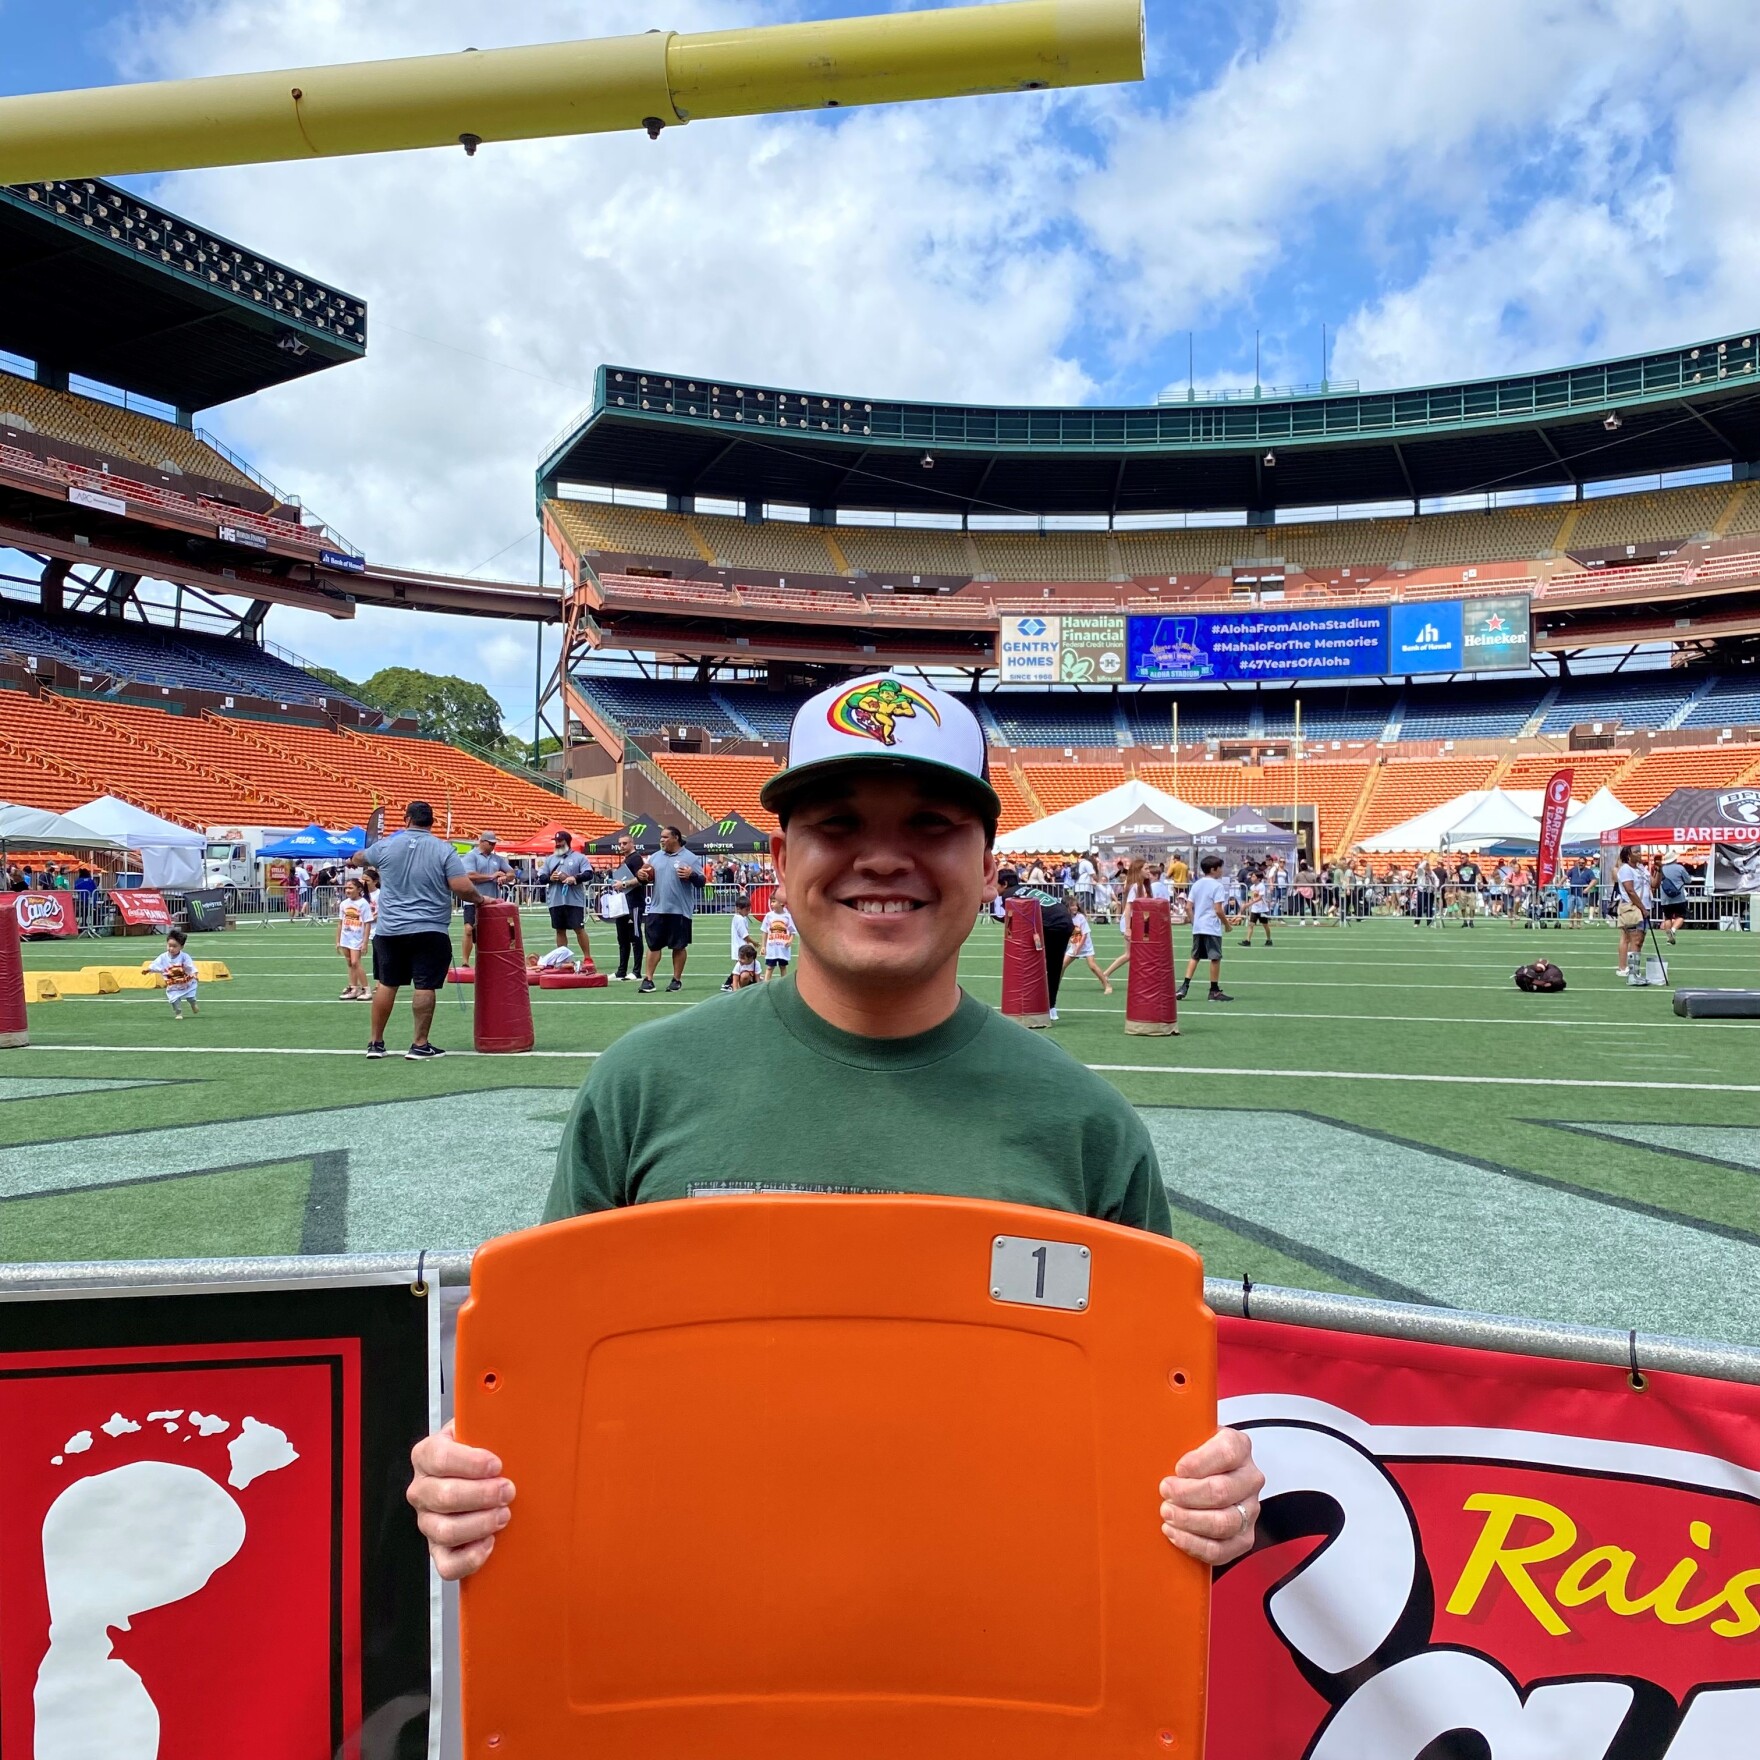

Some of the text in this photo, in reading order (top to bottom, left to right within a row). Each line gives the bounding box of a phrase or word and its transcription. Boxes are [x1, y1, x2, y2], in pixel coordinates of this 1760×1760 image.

[1062, 616, 1123, 628] Hawaiian
[1211, 618, 1380, 634] #AlohaFromAlohaStadium
[1062, 629, 1123, 641] Financial
[1464, 633, 1526, 647] Heineken
[1003, 642, 1058, 652] GENTRY
[1213, 640, 1311, 652] #MahaloForThe
[1315, 636, 1378, 649] Memories
[1008, 657, 1053, 666] HOMES
[1239, 657, 1350, 670] #47YearsOfAloha
[1544, 806, 1555, 846] LEAGUE
[1032, 1246, 1046, 1298] 1
[1446, 1493, 1760, 1637] Rais
